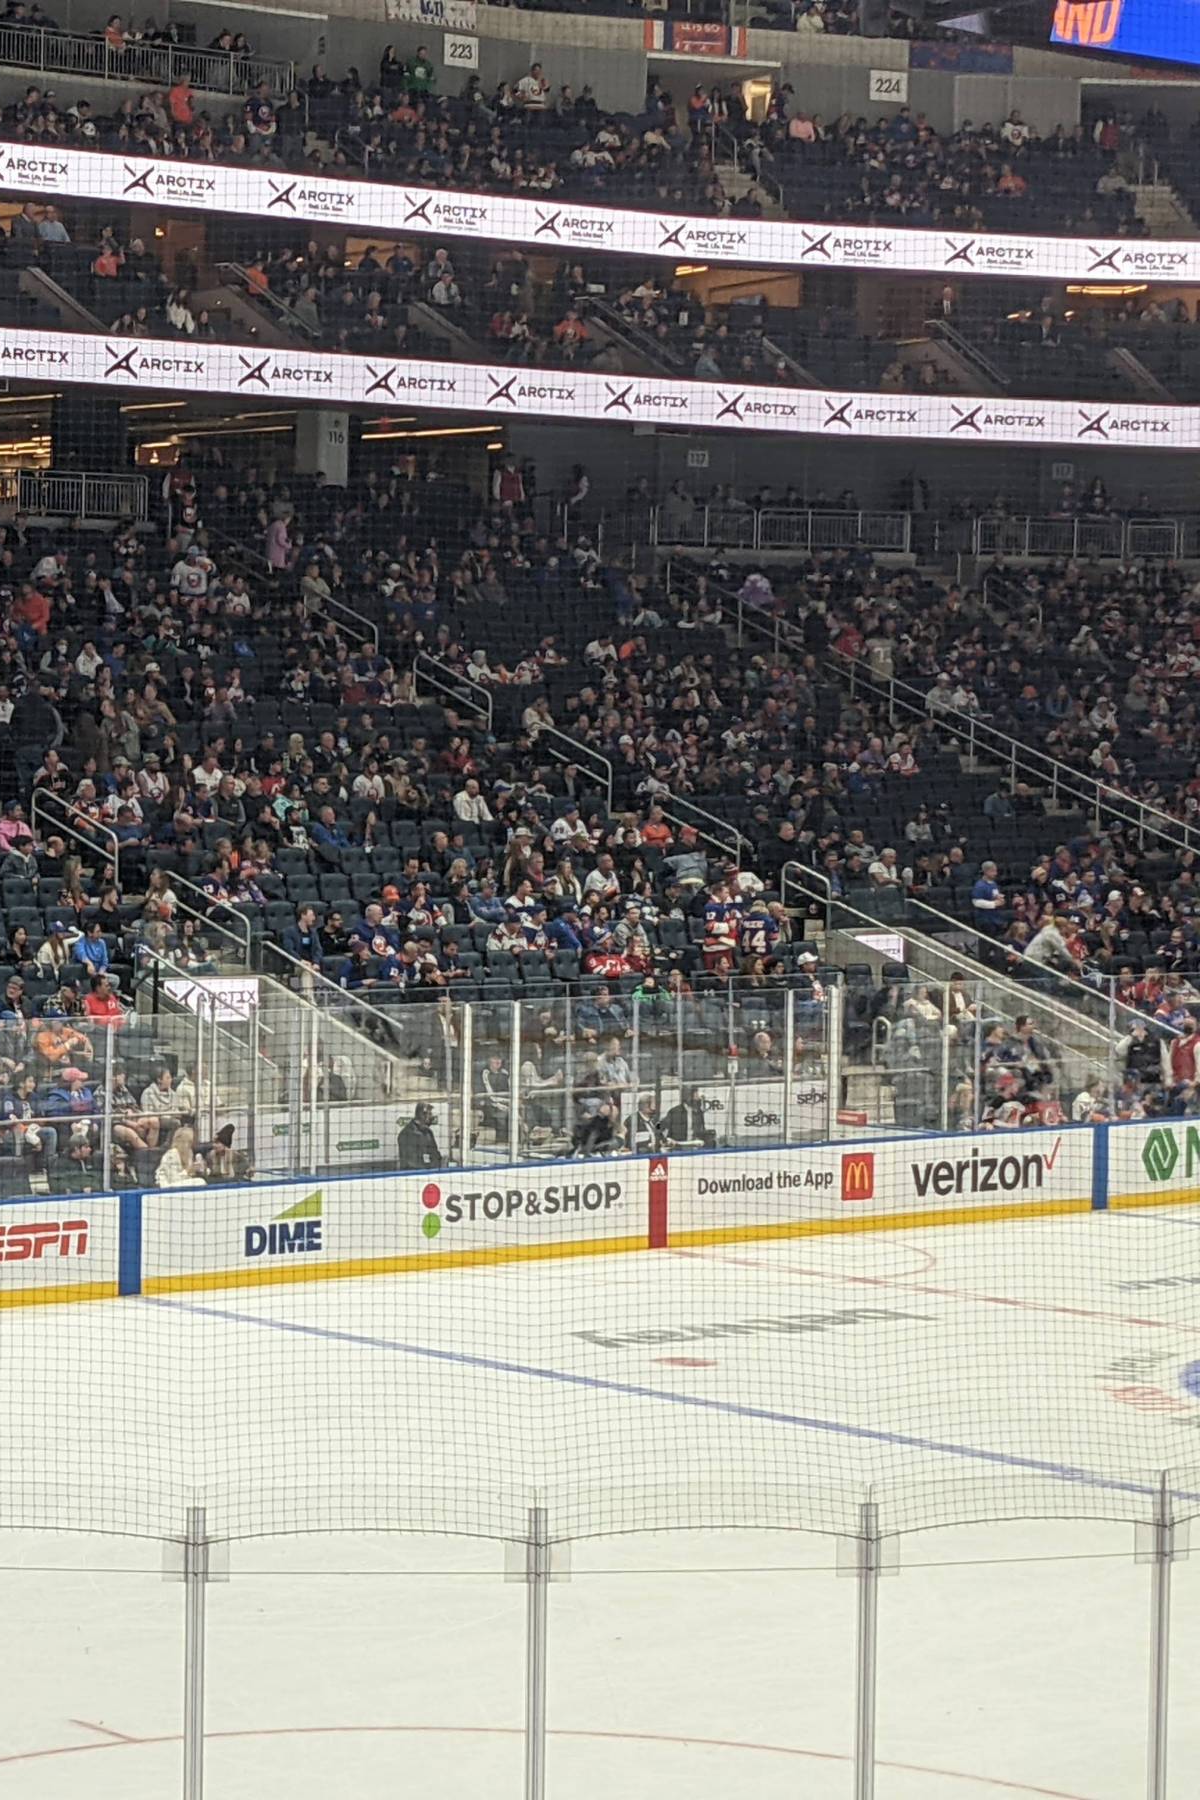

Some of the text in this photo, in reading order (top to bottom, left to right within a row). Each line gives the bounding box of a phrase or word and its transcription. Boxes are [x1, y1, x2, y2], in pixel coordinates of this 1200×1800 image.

[450, 43, 473, 59] 223
[875, 79, 899, 93] 224
[6, 158, 68, 175] ARCTIX
[156, 175, 215, 190] ARCTIX
[298, 190, 354, 206] ARCTIX
[434, 204, 487, 219] ARCTIX
[562, 218, 615, 232] ARCTIX
[686, 230, 746, 244] ARCTIX
[833, 238, 892, 252] ARCTIX
[976, 247, 1034, 259] ARCTIX
[1122, 252, 1188, 264] ARCTIX
[1, 348, 69, 364] ARCTIX
[139, 358, 204, 374] ARCTIX
[272, 367, 333, 382] ARCTIX
[397, 376, 456, 392] ARCTIX
[518, 386, 575, 400] ARCTIX
[634, 394, 688, 408] ARCTIX
[744, 402, 798, 416] ARCTIX
[854, 409, 917, 423] ARCTIX
[983, 415, 1045, 428] ARCTIX
[1109, 419, 1170, 432] ARCTIX
[329, 431, 345, 445] 116
[911, 1147, 1043, 1197] verizon
[698, 1169, 833, 1195] Download the App
[445, 1181, 621, 1223] STOP&SHOP
[245, 1220, 322, 1257] DIME
